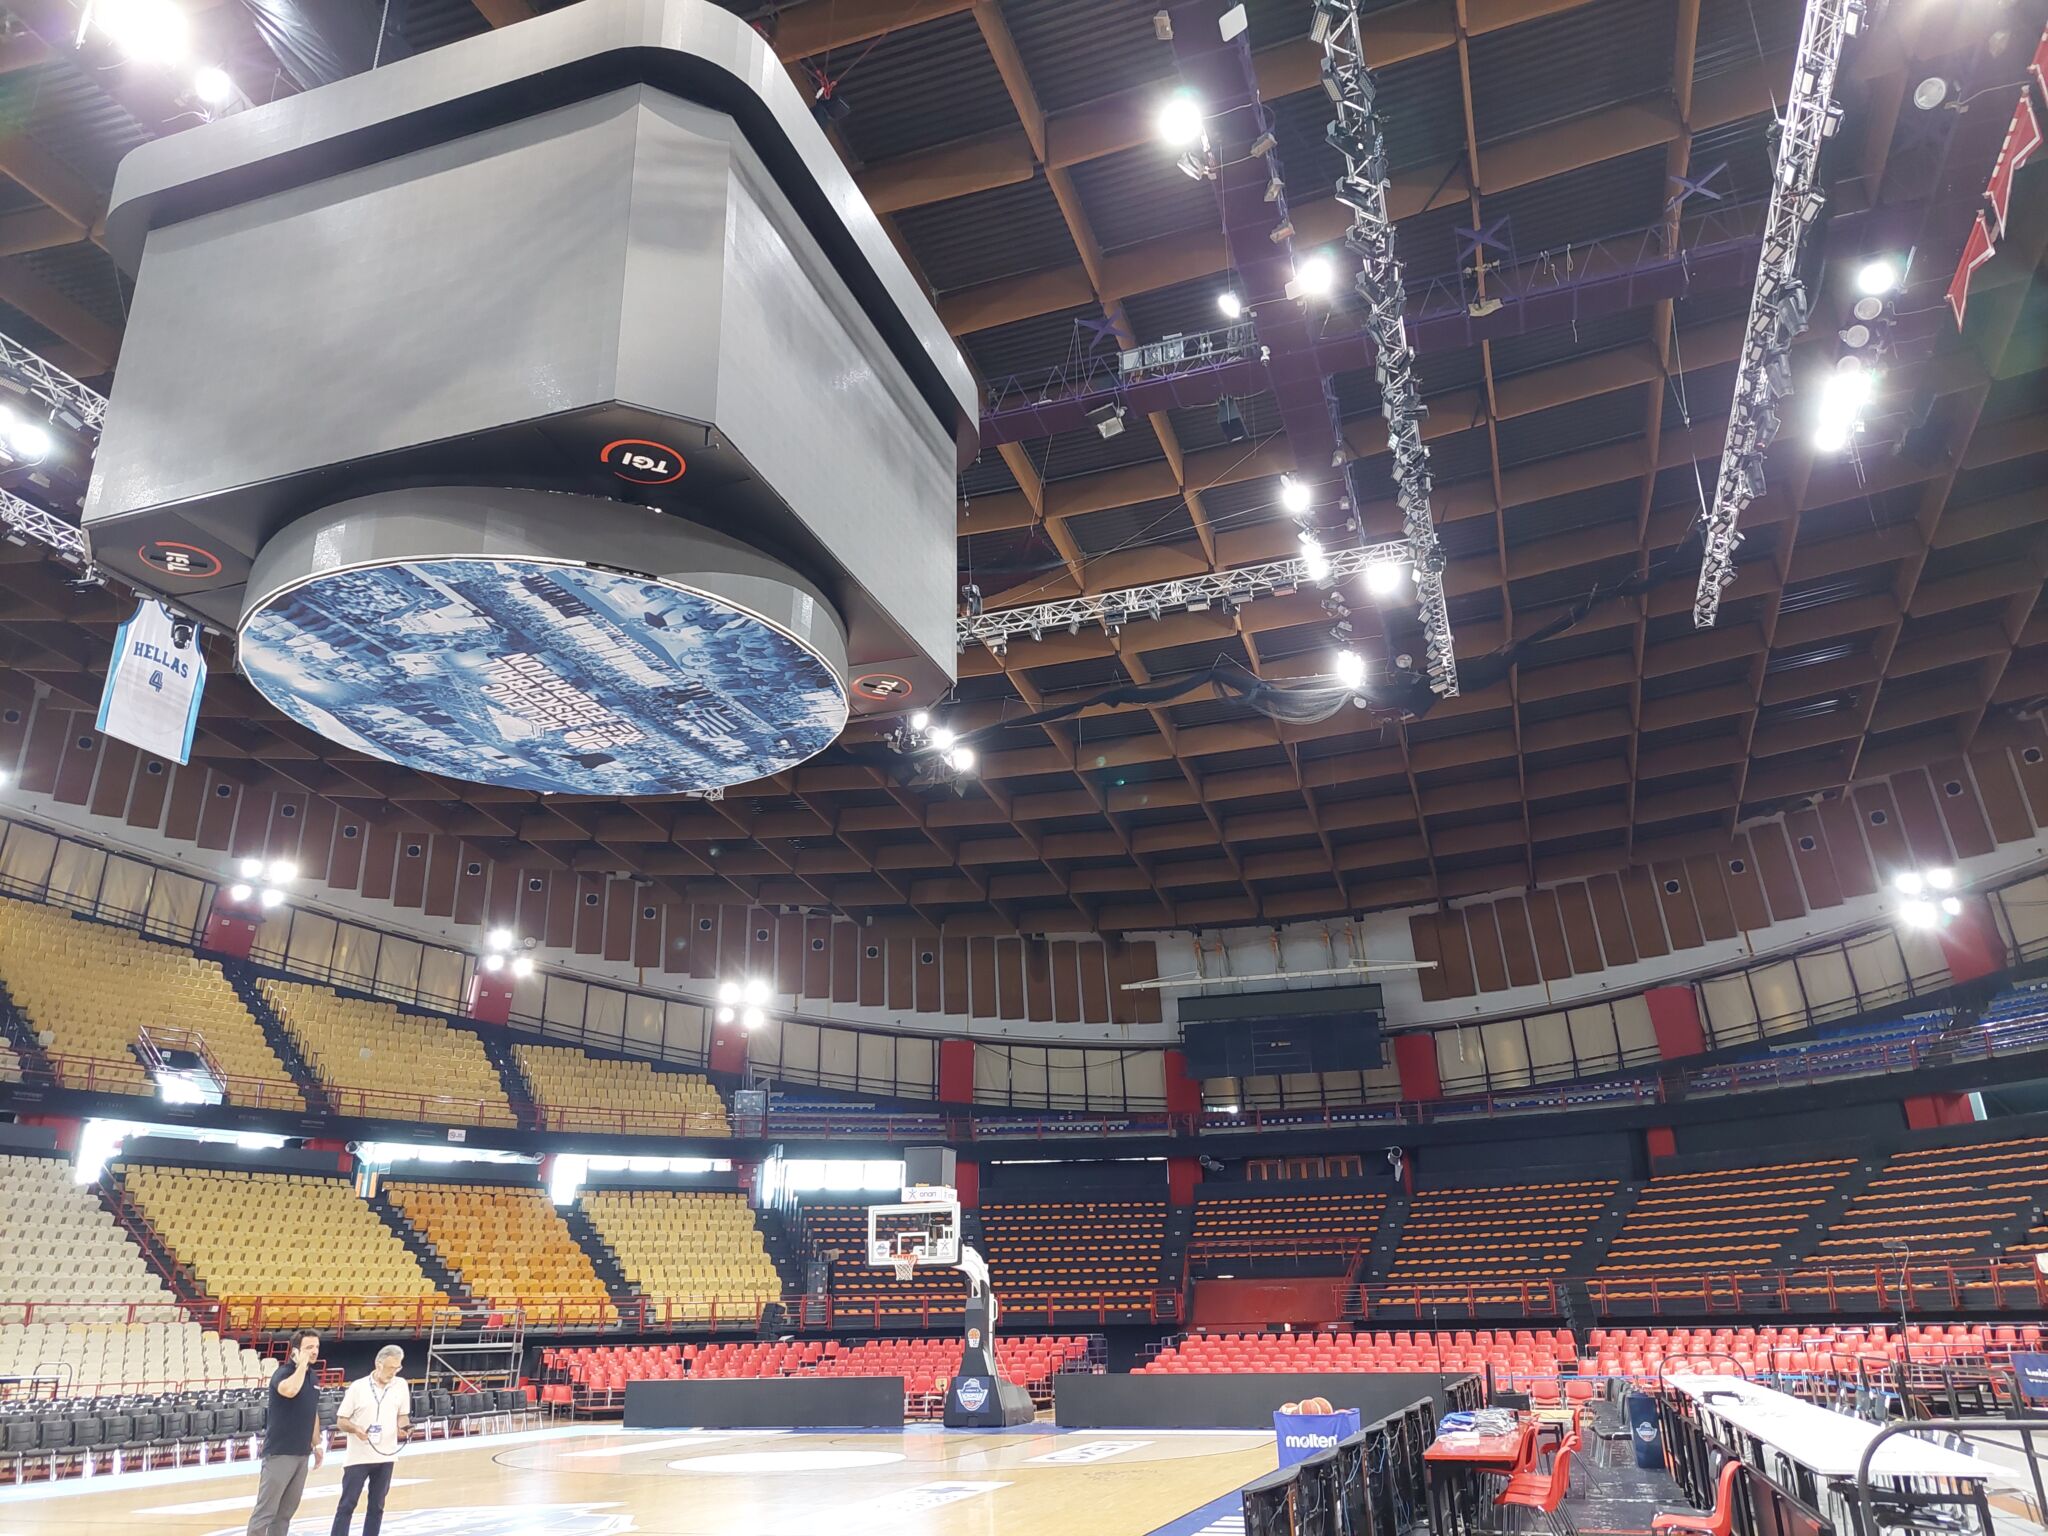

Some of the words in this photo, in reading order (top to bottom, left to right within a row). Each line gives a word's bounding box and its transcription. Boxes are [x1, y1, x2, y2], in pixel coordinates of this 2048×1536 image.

[622, 452, 669, 474] TGI
[133, 641, 189, 679] HELLAS
[149, 670, 163, 692] 4
[480, 657, 593, 727] BASKETBALL
[504, 652, 619, 722] FEDERATION
[480, 682, 568, 731] HELLENIC
[1285, 1433, 1338, 1449] molten
